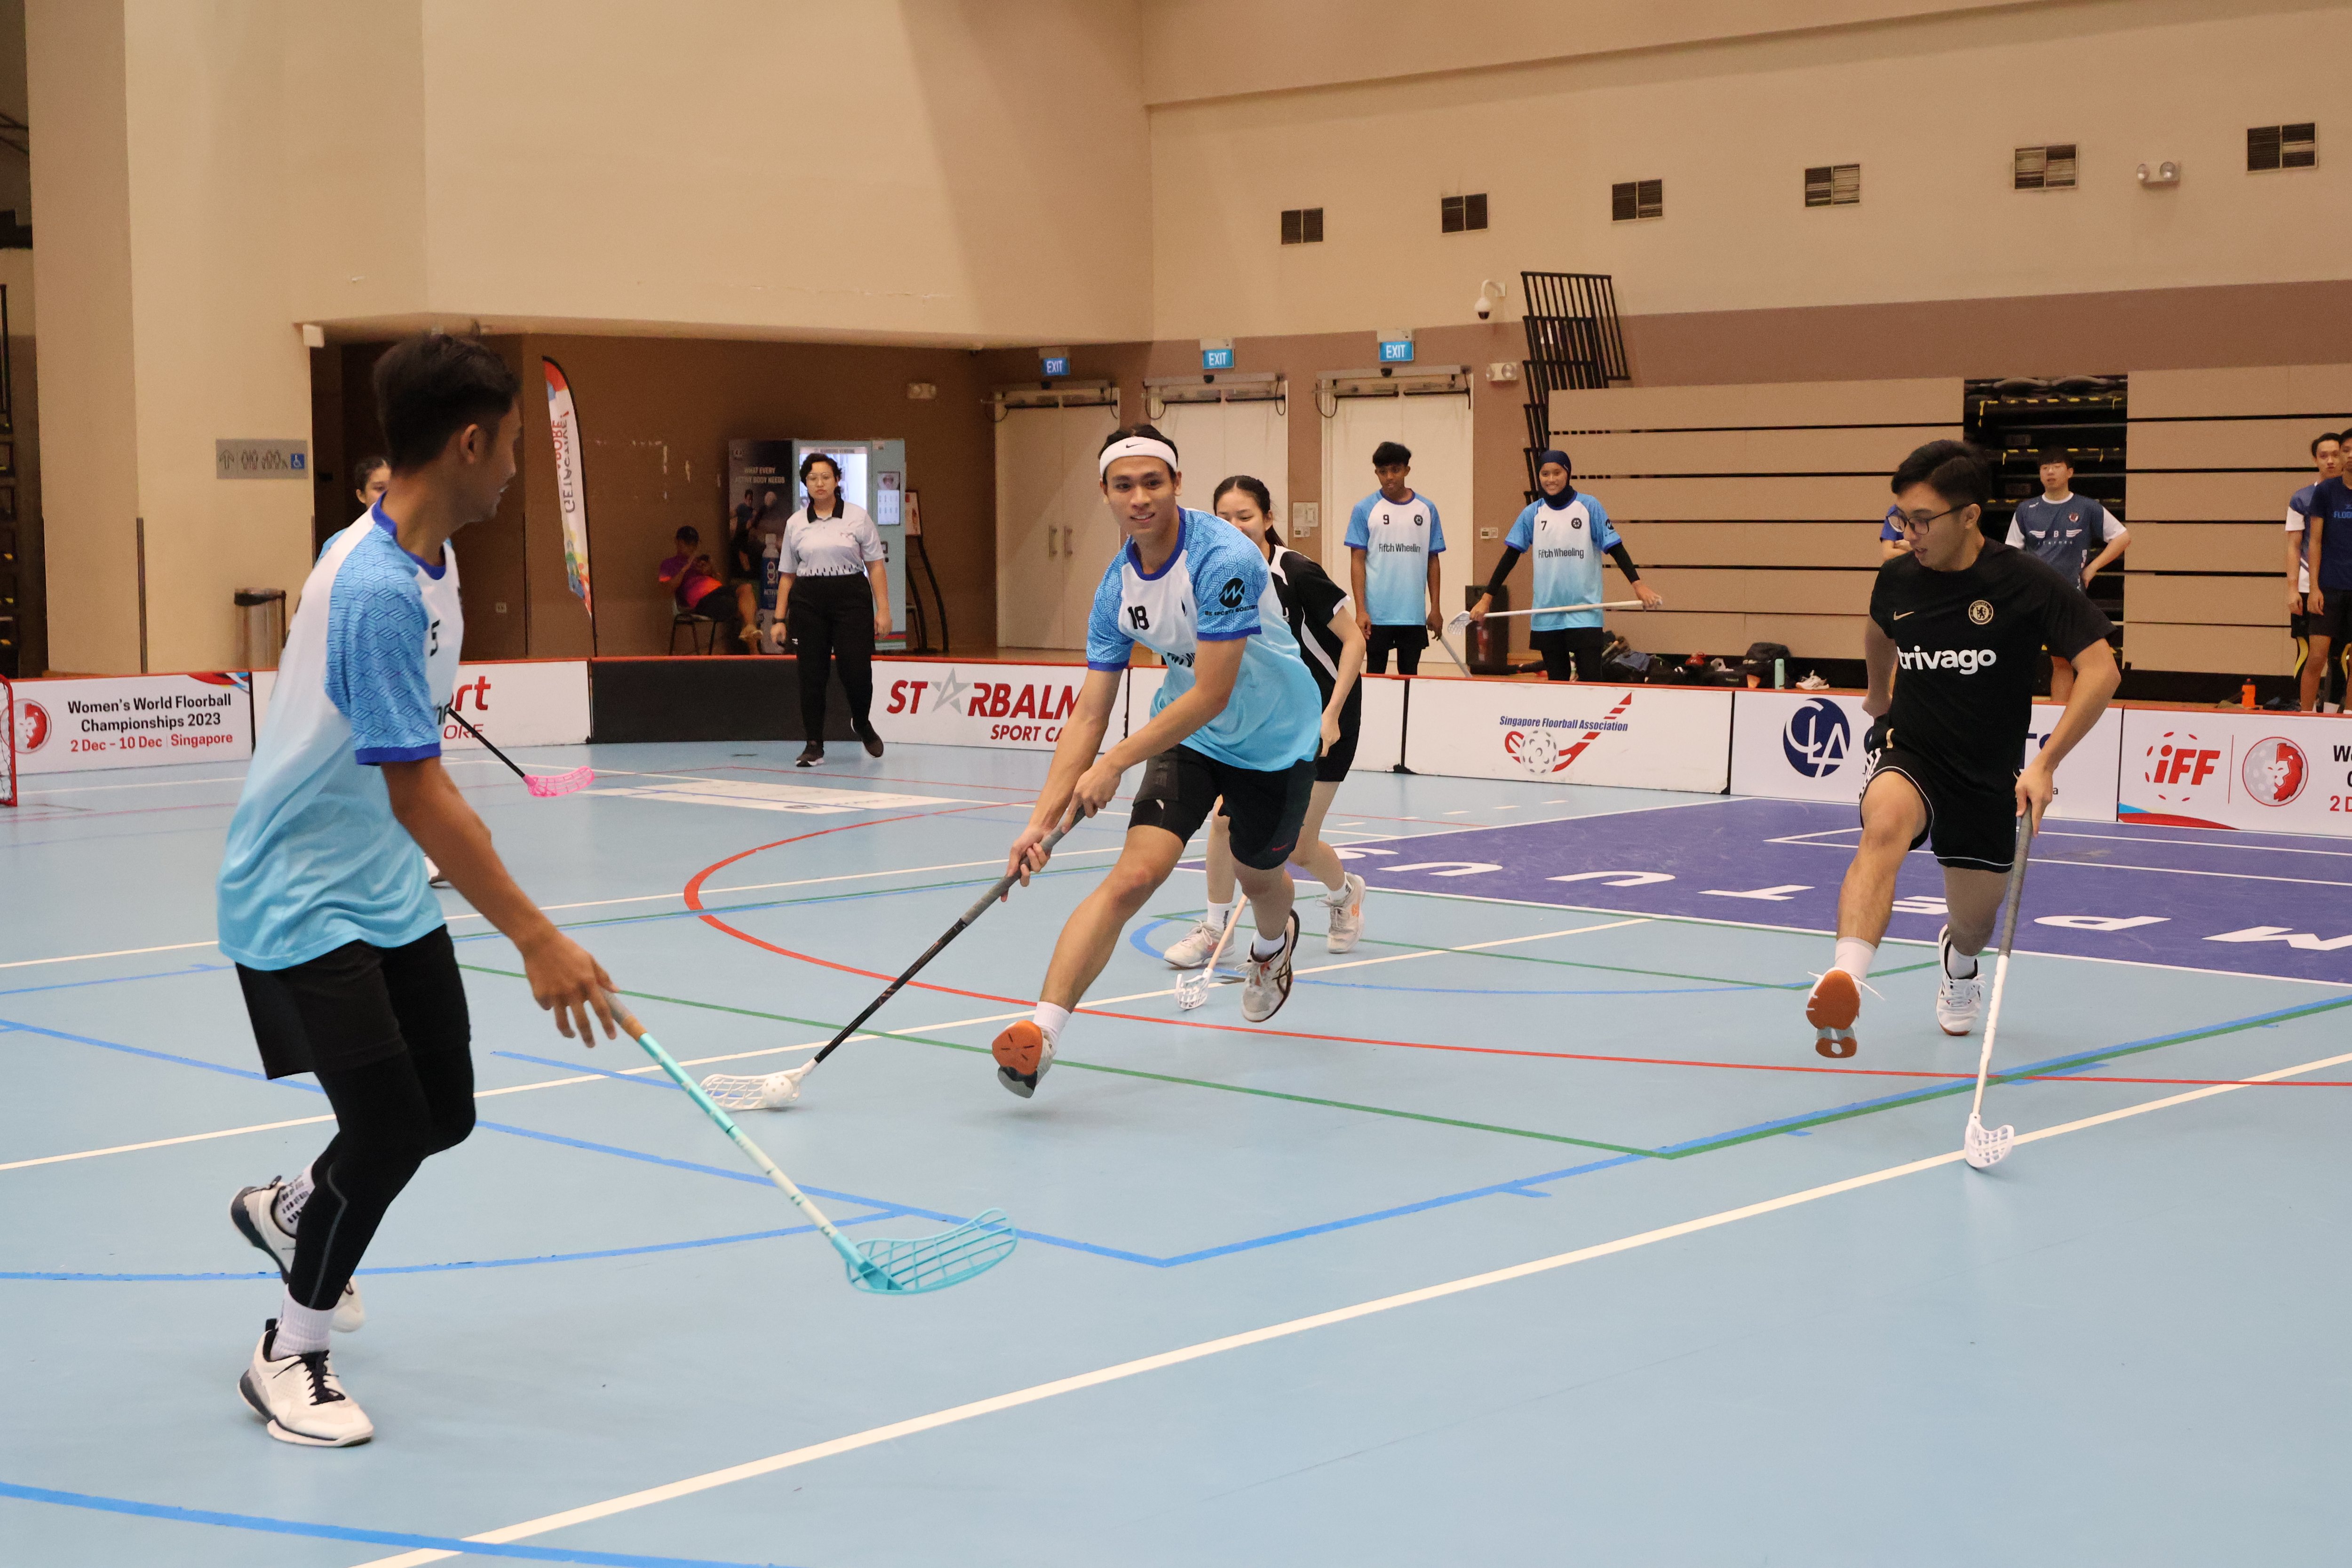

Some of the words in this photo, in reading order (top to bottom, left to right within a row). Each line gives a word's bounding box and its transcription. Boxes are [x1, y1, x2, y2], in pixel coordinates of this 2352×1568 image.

[1208, 351, 1227, 366] EXIT
[1386, 343, 1406, 359] EXIT
[1046, 358, 1064, 374] EXIT
[1383, 514, 1390, 525] 9
[1541, 520, 1547, 531] 7
[1379, 543, 1394, 553] Fifth
[1395, 543, 1421, 553] Wheelin
[1538, 549, 1553, 559] Fifth
[1554, 548, 1584, 559] Wheeling
[1128, 605, 1149, 630] 18
[430, 619, 441, 657] 5
[1897, 645, 1997, 675] trivago
[449, 676, 491, 712] rt
[68, 699, 130, 714] Women's
[133, 696, 172, 710] World
[175, 693, 231, 708] Floorball
[81, 715, 184, 733] Championships
[188, 712, 221, 726] 2023
[1500, 716, 1540, 727] Singapore
[1542, 718, 1578, 729] Floorball
[1579, 719, 1628, 732] Association
[990, 724, 1041, 741] SPORT
[71, 740, 79, 752] 2
[82, 739, 106, 752] Dec
[119, 736, 135, 749] 10
[138, 735, 162, 748] Dec
[171, 733, 233, 748] Singapore
[2329, 795, 2340, 812] 2
